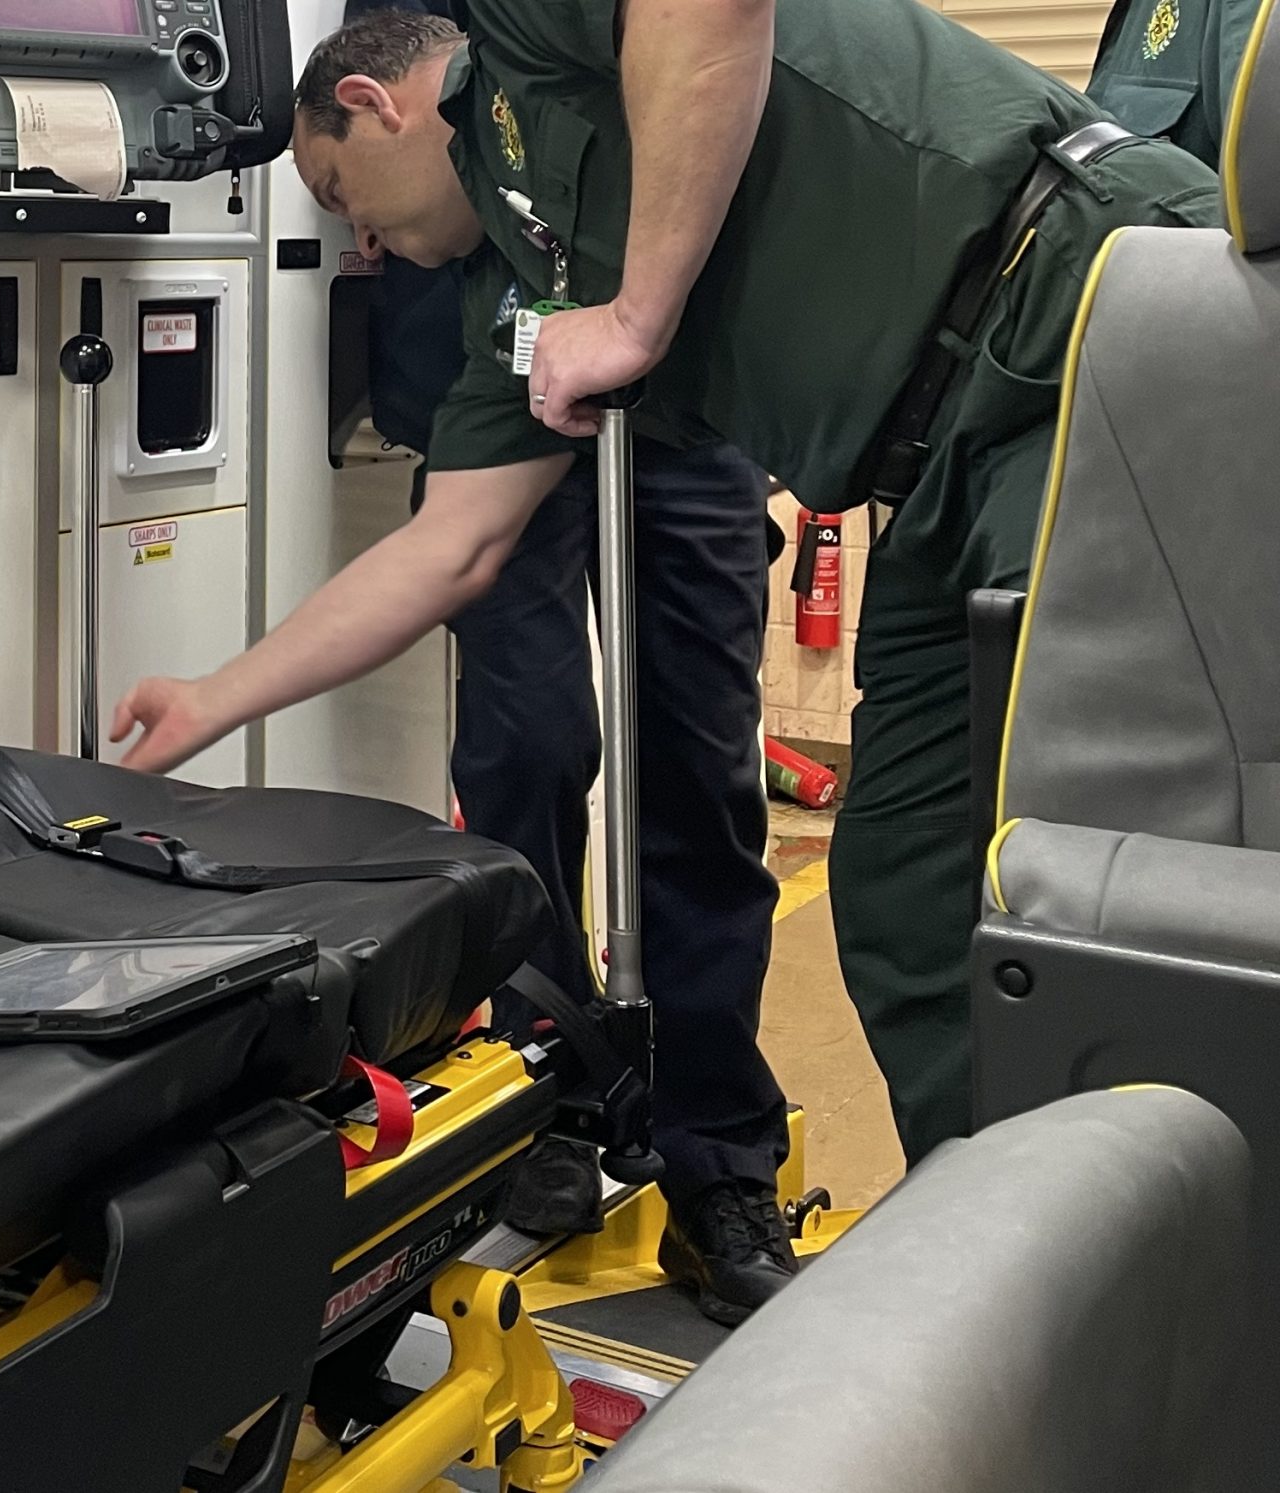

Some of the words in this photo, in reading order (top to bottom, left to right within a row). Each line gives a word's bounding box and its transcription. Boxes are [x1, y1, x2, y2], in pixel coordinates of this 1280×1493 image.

[147, 319, 173, 331] CLINICAL
[174, 318, 192, 331] WASTE
[162, 333, 177, 346] ONLY
[134, 527, 157, 543] SHARPS
[157, 525, 172, 539] ONLY
[321, 1246, 410, 1329] ower
